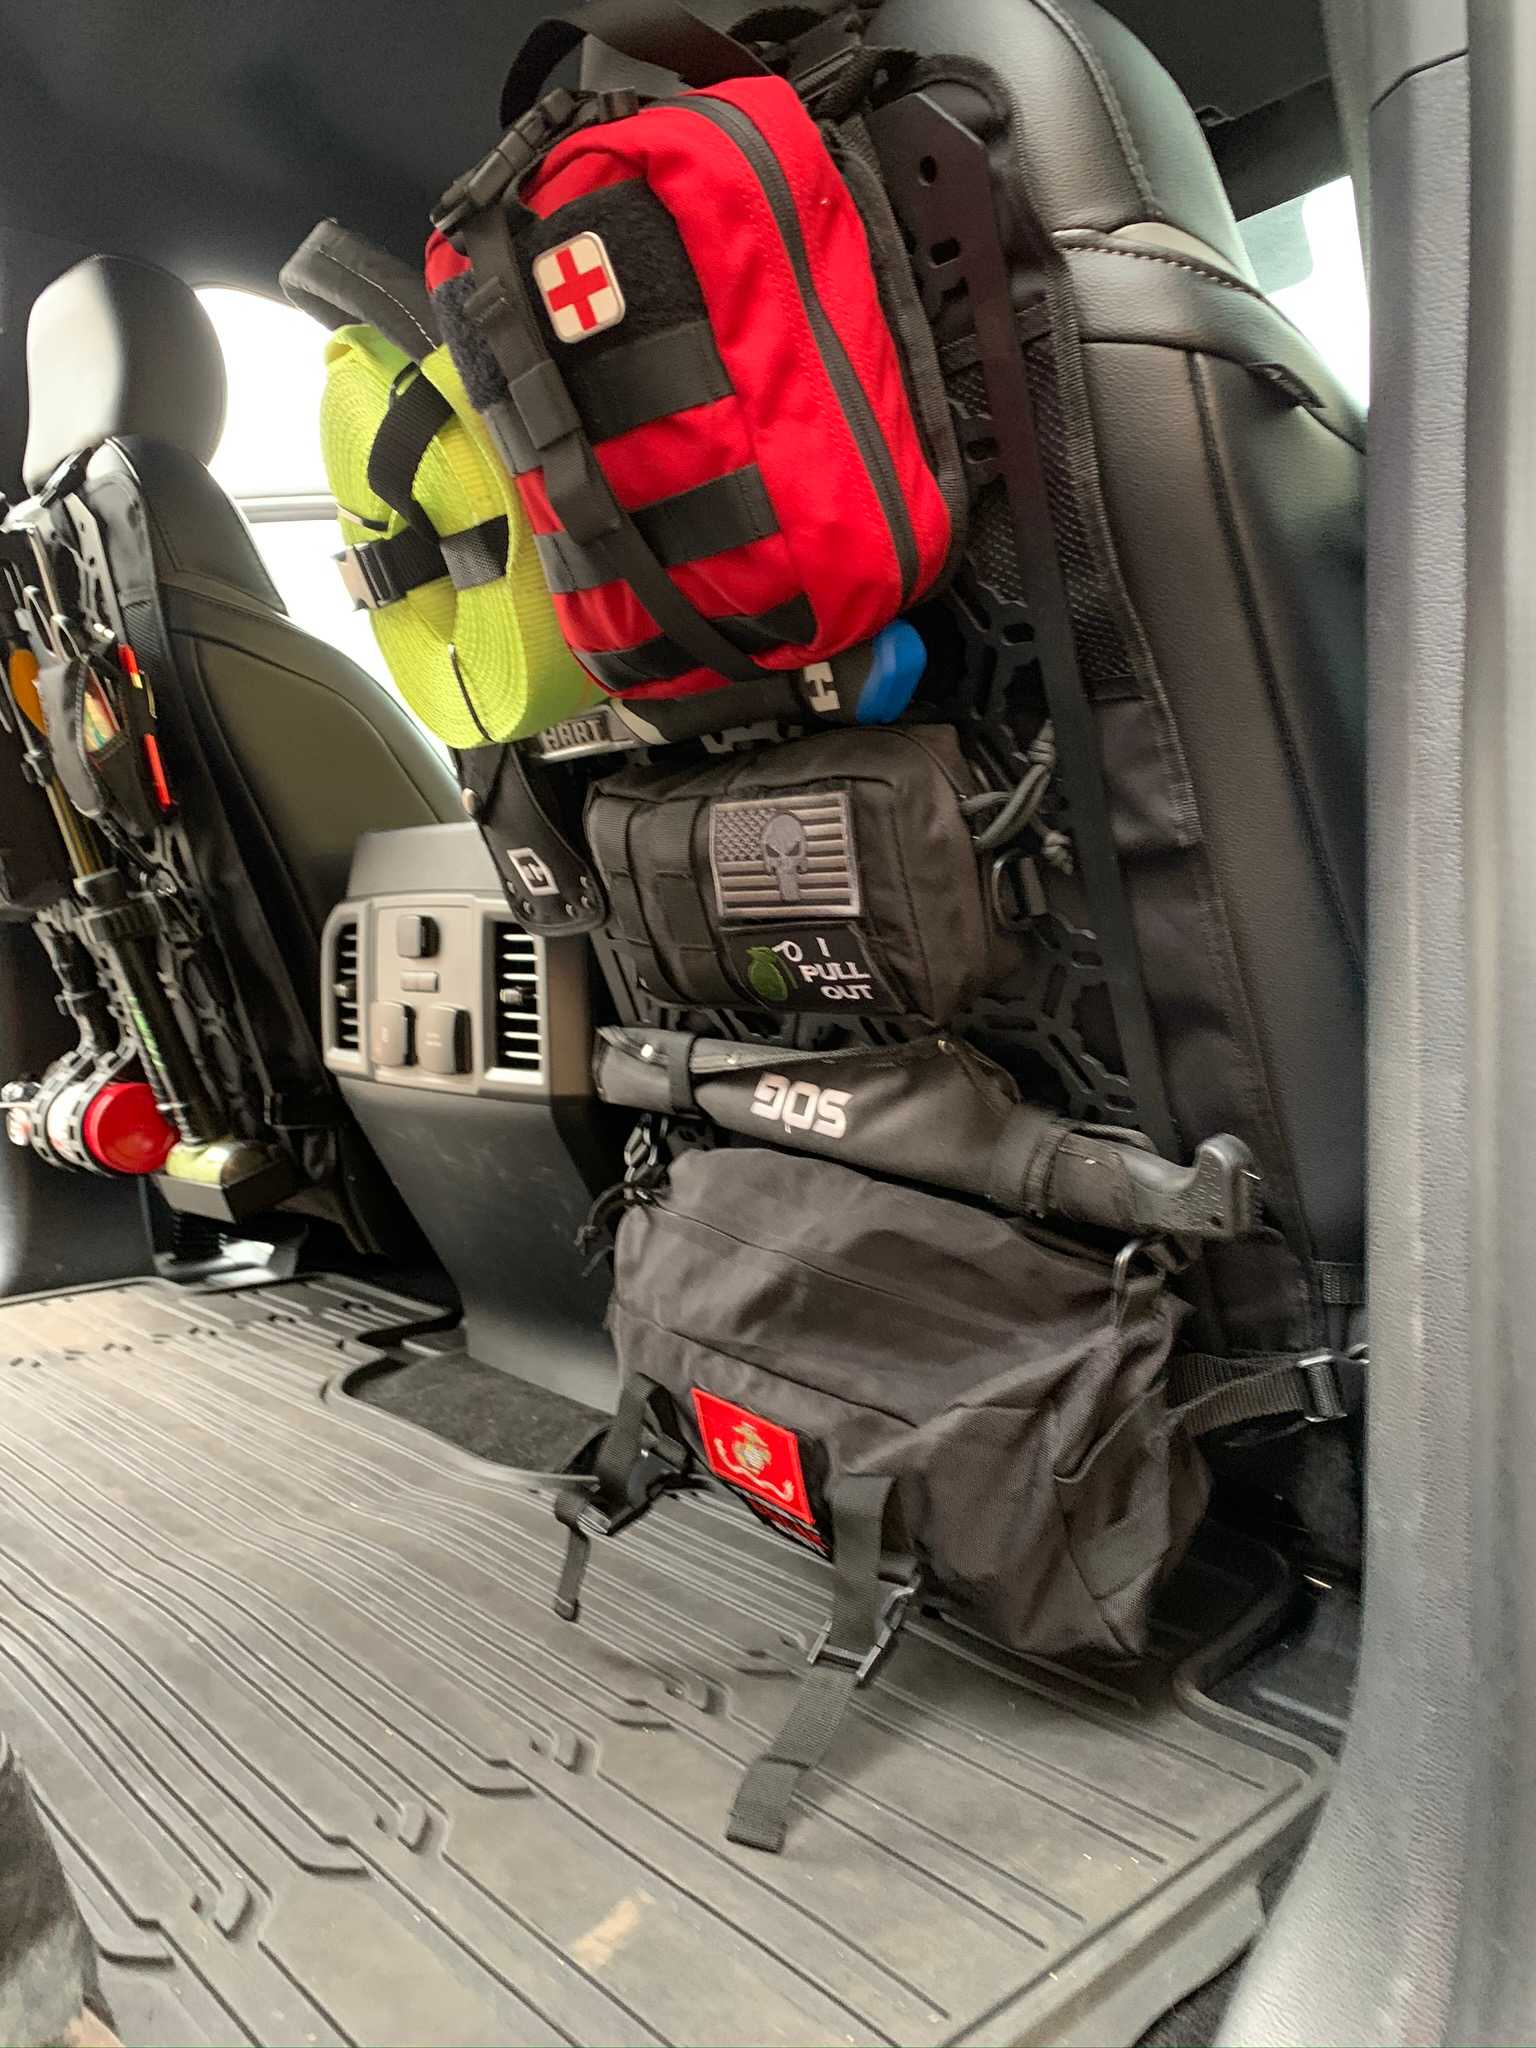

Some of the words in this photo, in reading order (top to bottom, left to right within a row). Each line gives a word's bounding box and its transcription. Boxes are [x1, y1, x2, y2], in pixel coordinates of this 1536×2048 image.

[542, 719, 601, 751] HART
[816, 936, 831, 959] I
[798, 961, 872, 983] PULL
[820, 984, 874, 1000] OUT
[750, 1071, 855, 1139] SOG
